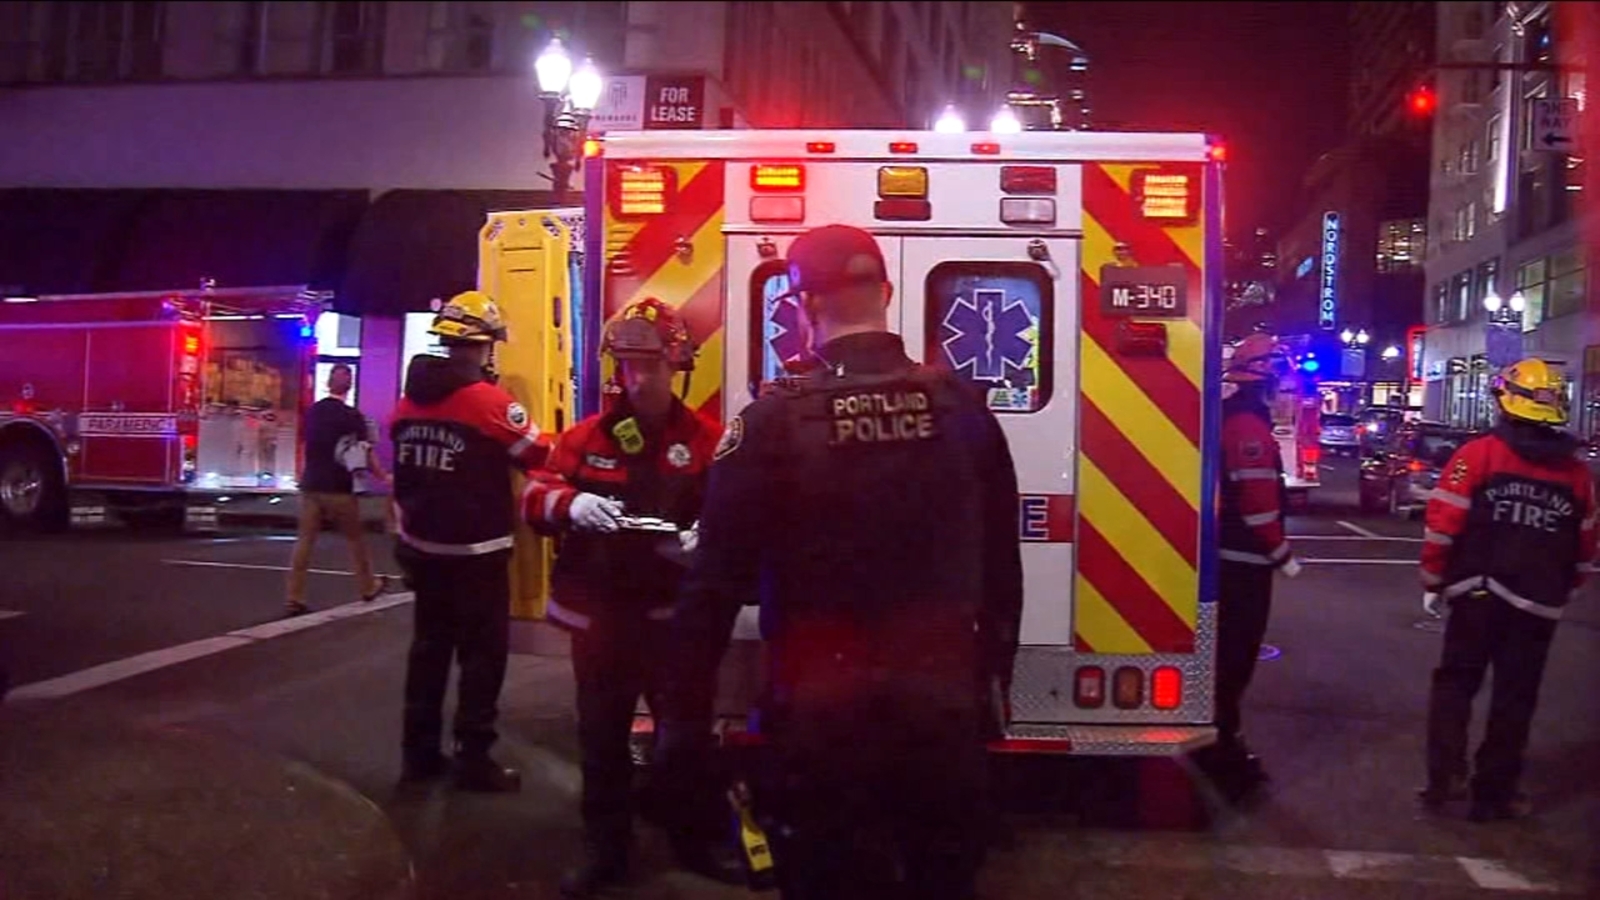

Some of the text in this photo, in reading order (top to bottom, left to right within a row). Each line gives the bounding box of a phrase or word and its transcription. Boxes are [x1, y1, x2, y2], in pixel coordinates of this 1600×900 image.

[659, 87, 689, 103] FOR
[650, 105, 695, 122] LEASE
[1322, 220, 1339, 320] NORDSTROM
[1112, 285, 1176, 309] M-340
[833, 392, 928, 416] PORTLAND
[835, 414, 934, 441] POLICE
[398, 443, 456, 472] FIRE
[1485, 482, 1573, 516] PORTLAND
[1493, 499, 1562, 533] FIRE
